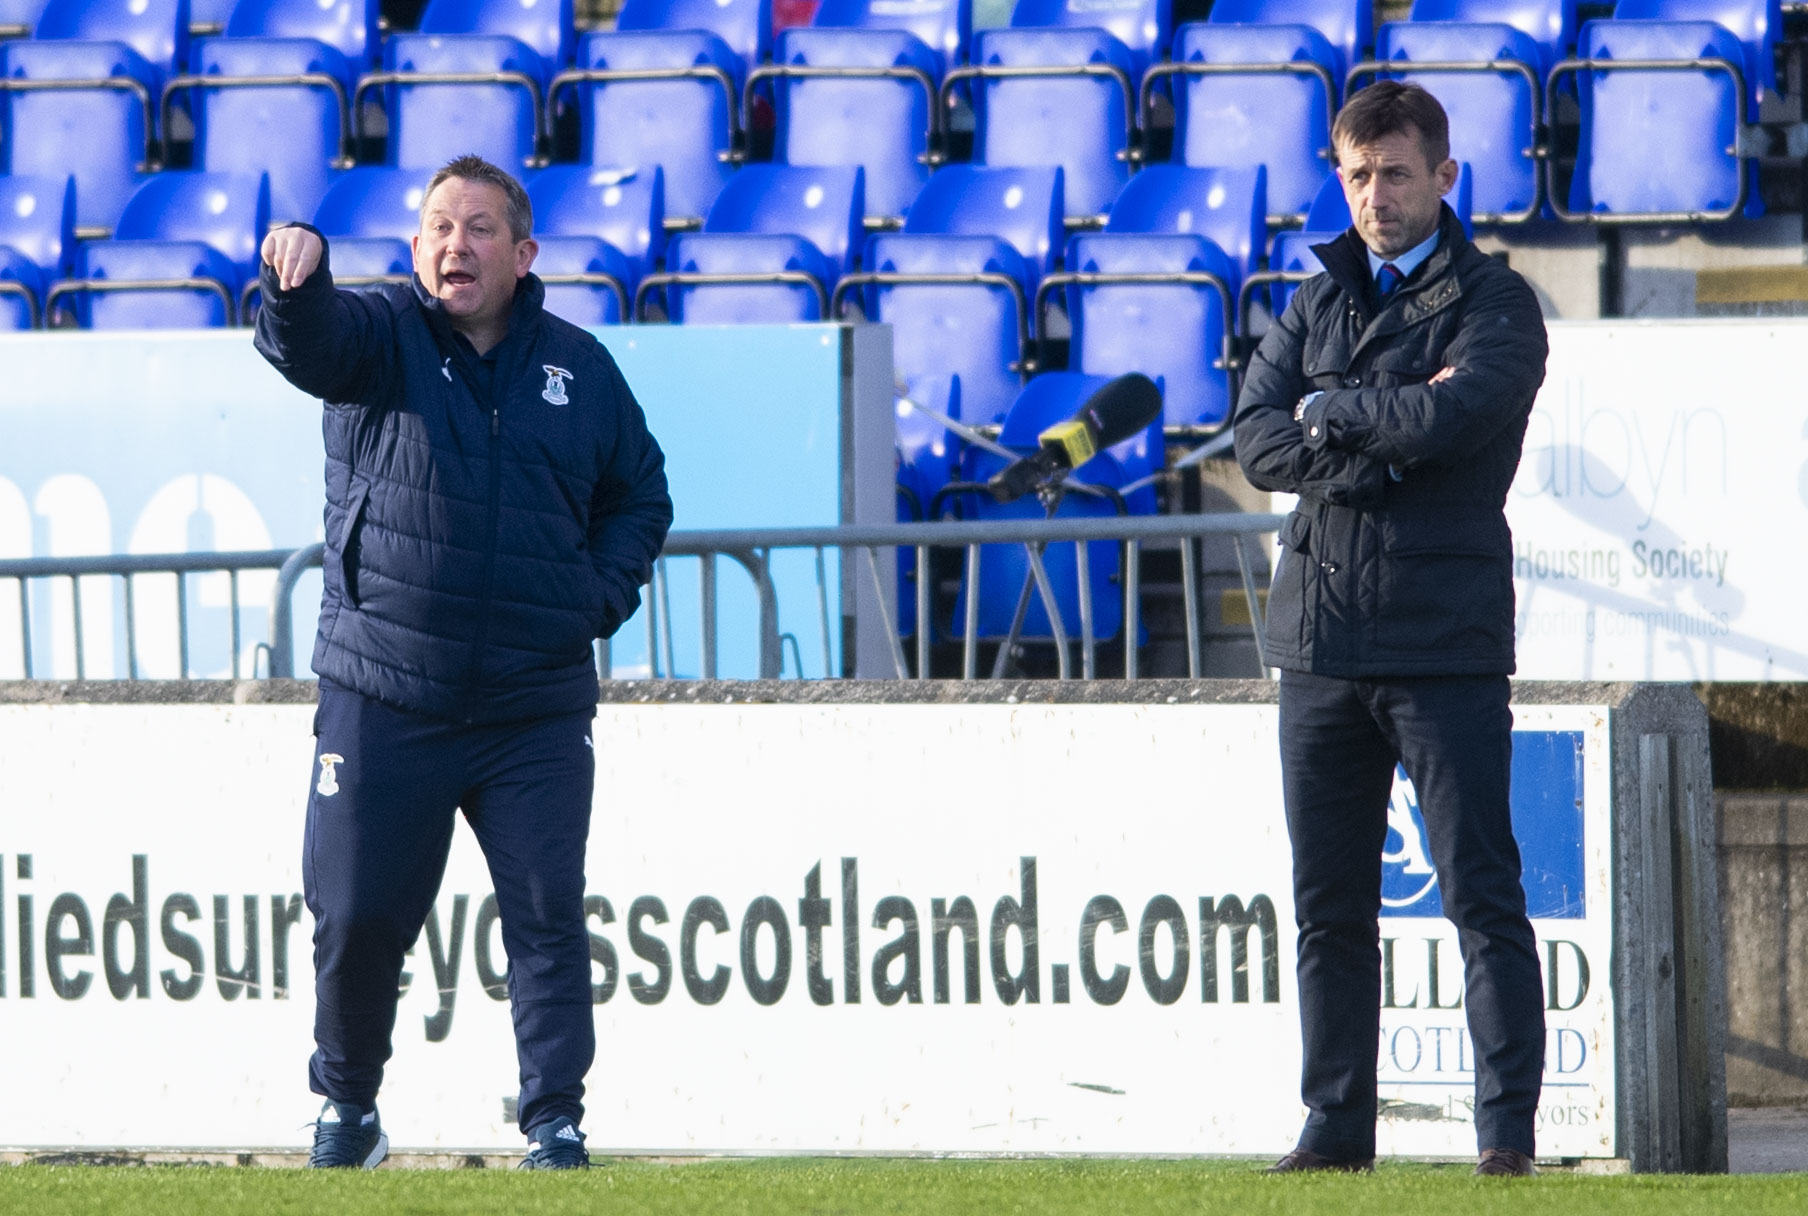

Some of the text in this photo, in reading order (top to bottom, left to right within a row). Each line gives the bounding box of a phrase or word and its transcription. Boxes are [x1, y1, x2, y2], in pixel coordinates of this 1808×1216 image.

[1515, 539, 1729, 588] Housing Society
[1603, 605, 1730, 637] communities
